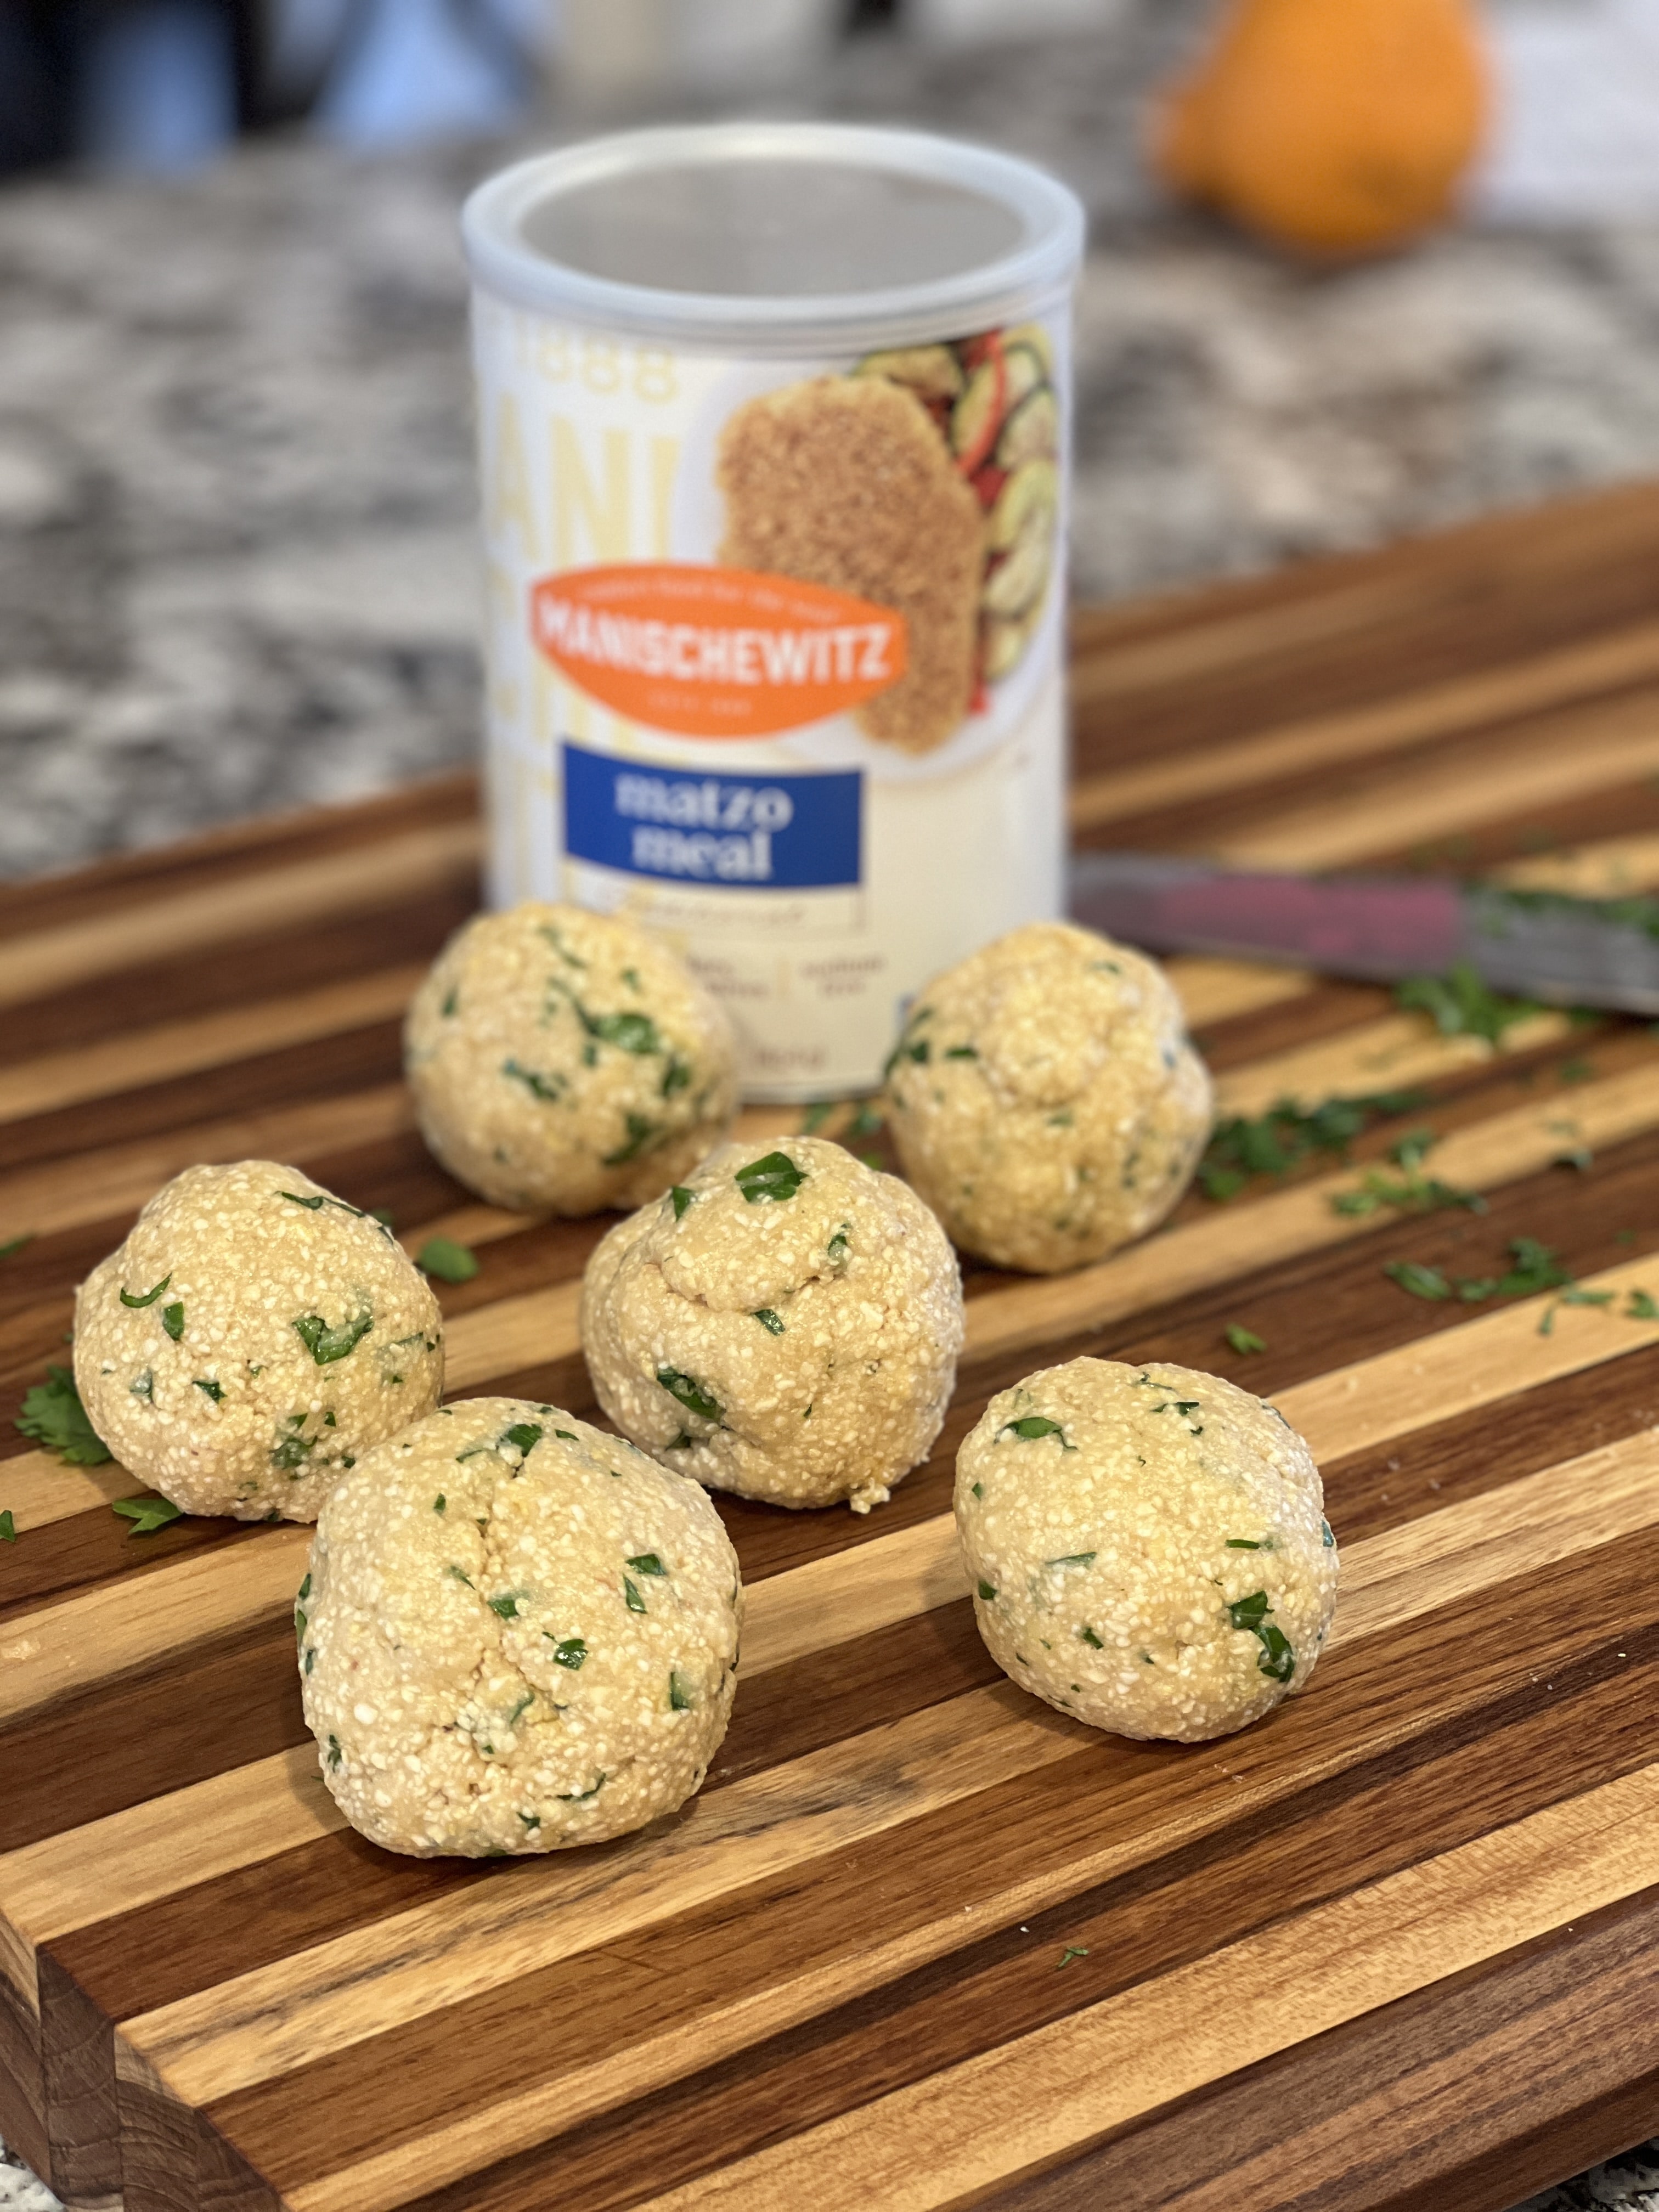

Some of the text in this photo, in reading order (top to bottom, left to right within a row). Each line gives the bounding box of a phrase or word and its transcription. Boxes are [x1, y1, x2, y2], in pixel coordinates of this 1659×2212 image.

[538, 592, 891, 687] MANISCHEWITZ
[616, 772, 794, 833] matzo
[632, 825, 774, 881] meal
